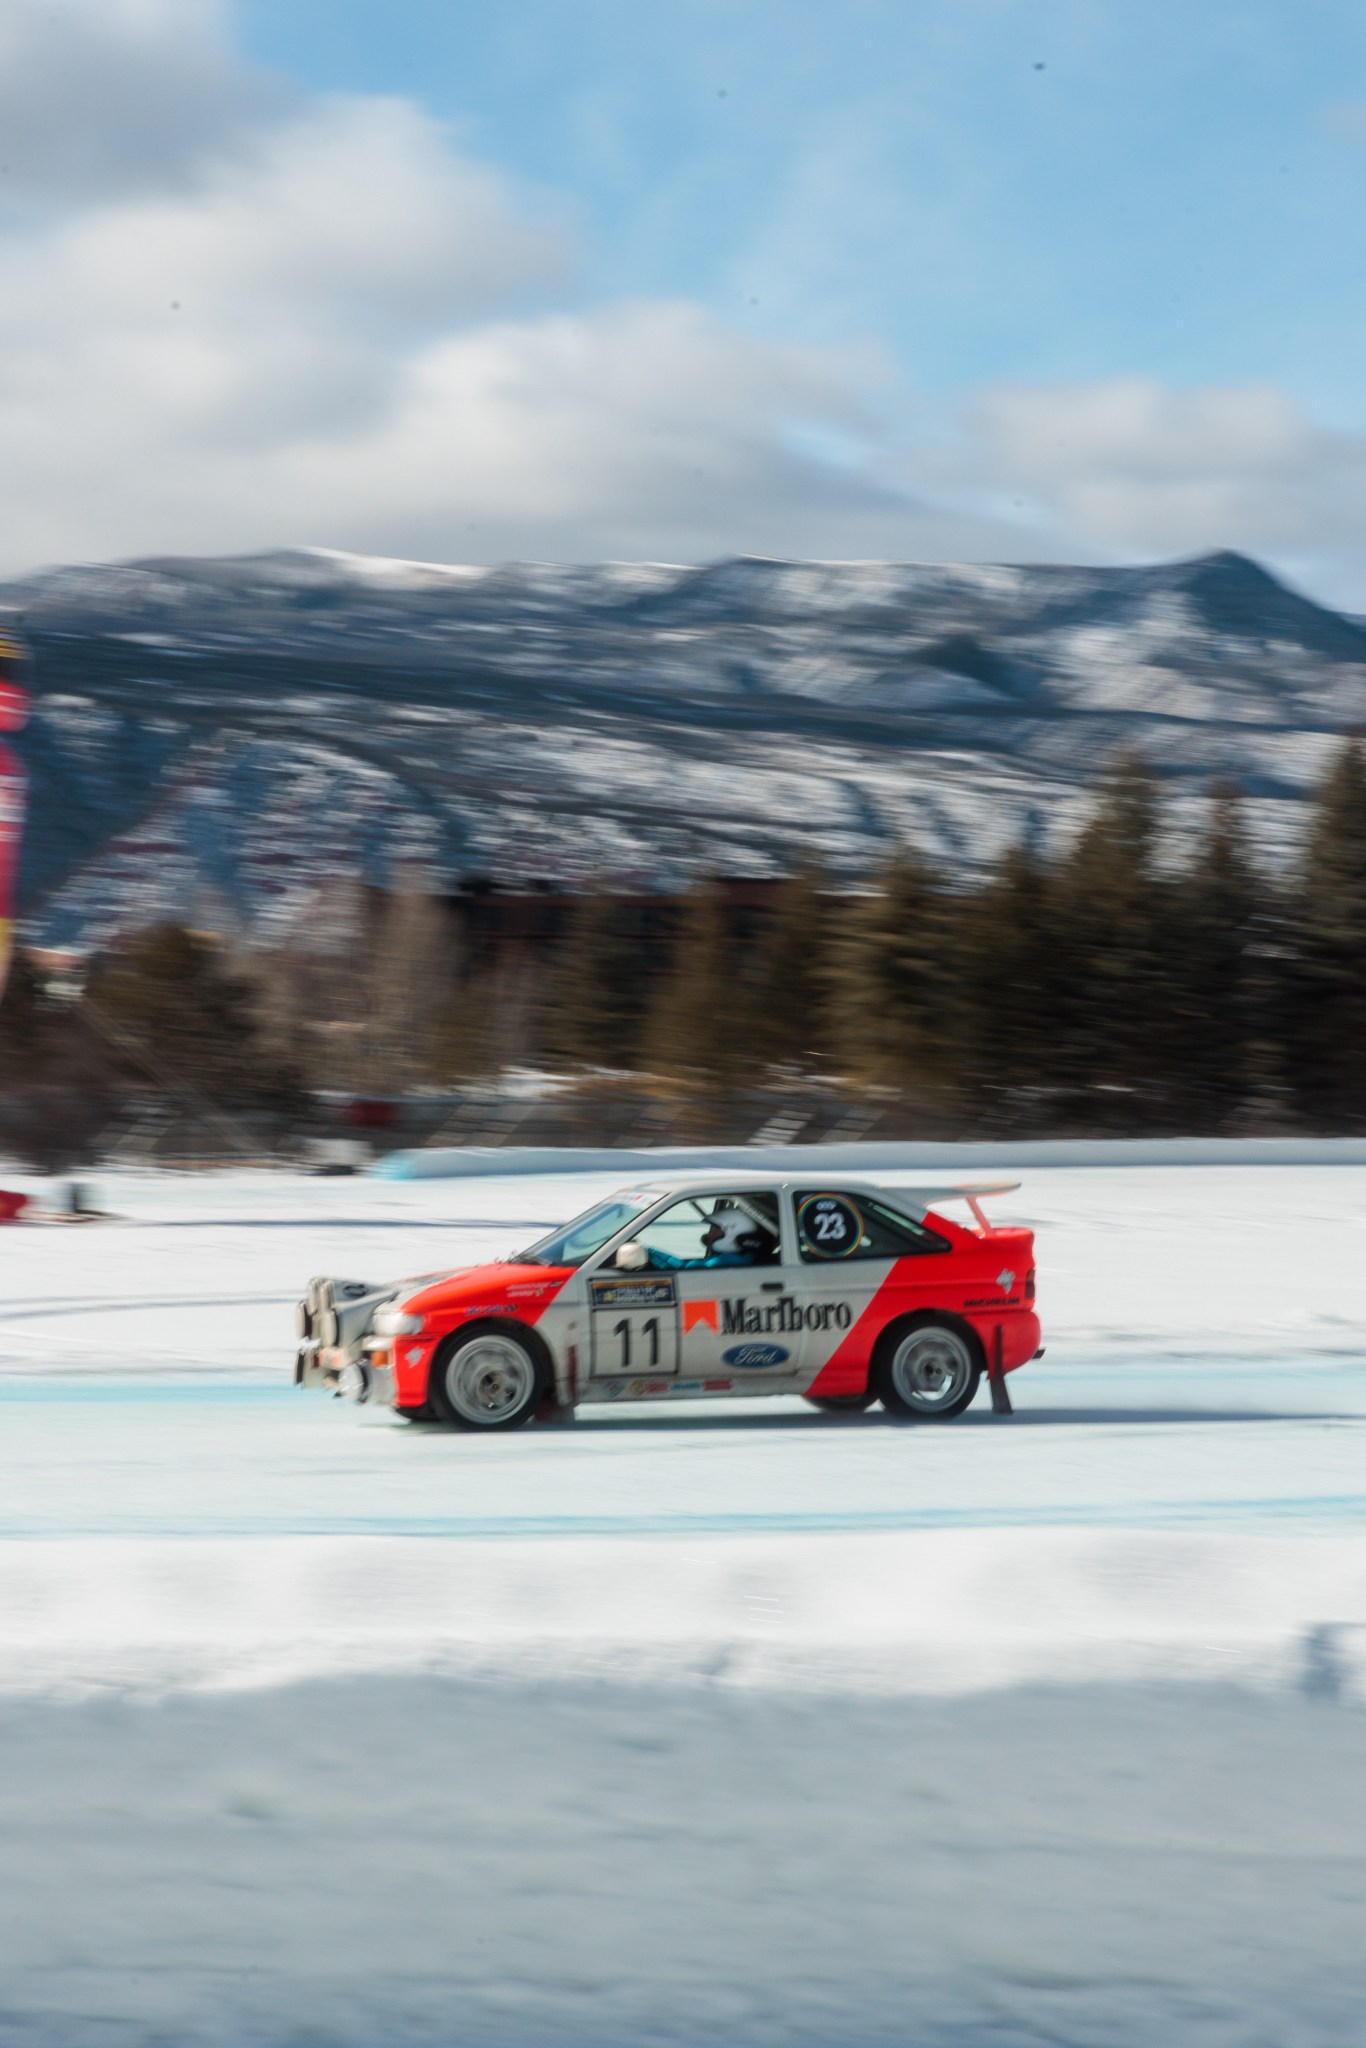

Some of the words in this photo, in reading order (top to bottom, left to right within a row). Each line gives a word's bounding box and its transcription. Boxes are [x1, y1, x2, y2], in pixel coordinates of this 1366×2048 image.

[814, 1212, 847, 1240] 23
[720, 1296, 851, 1336] Marlboro
[614, 1317, 658, 1367] 11
[734, 1345, 777, 1365] Ford
